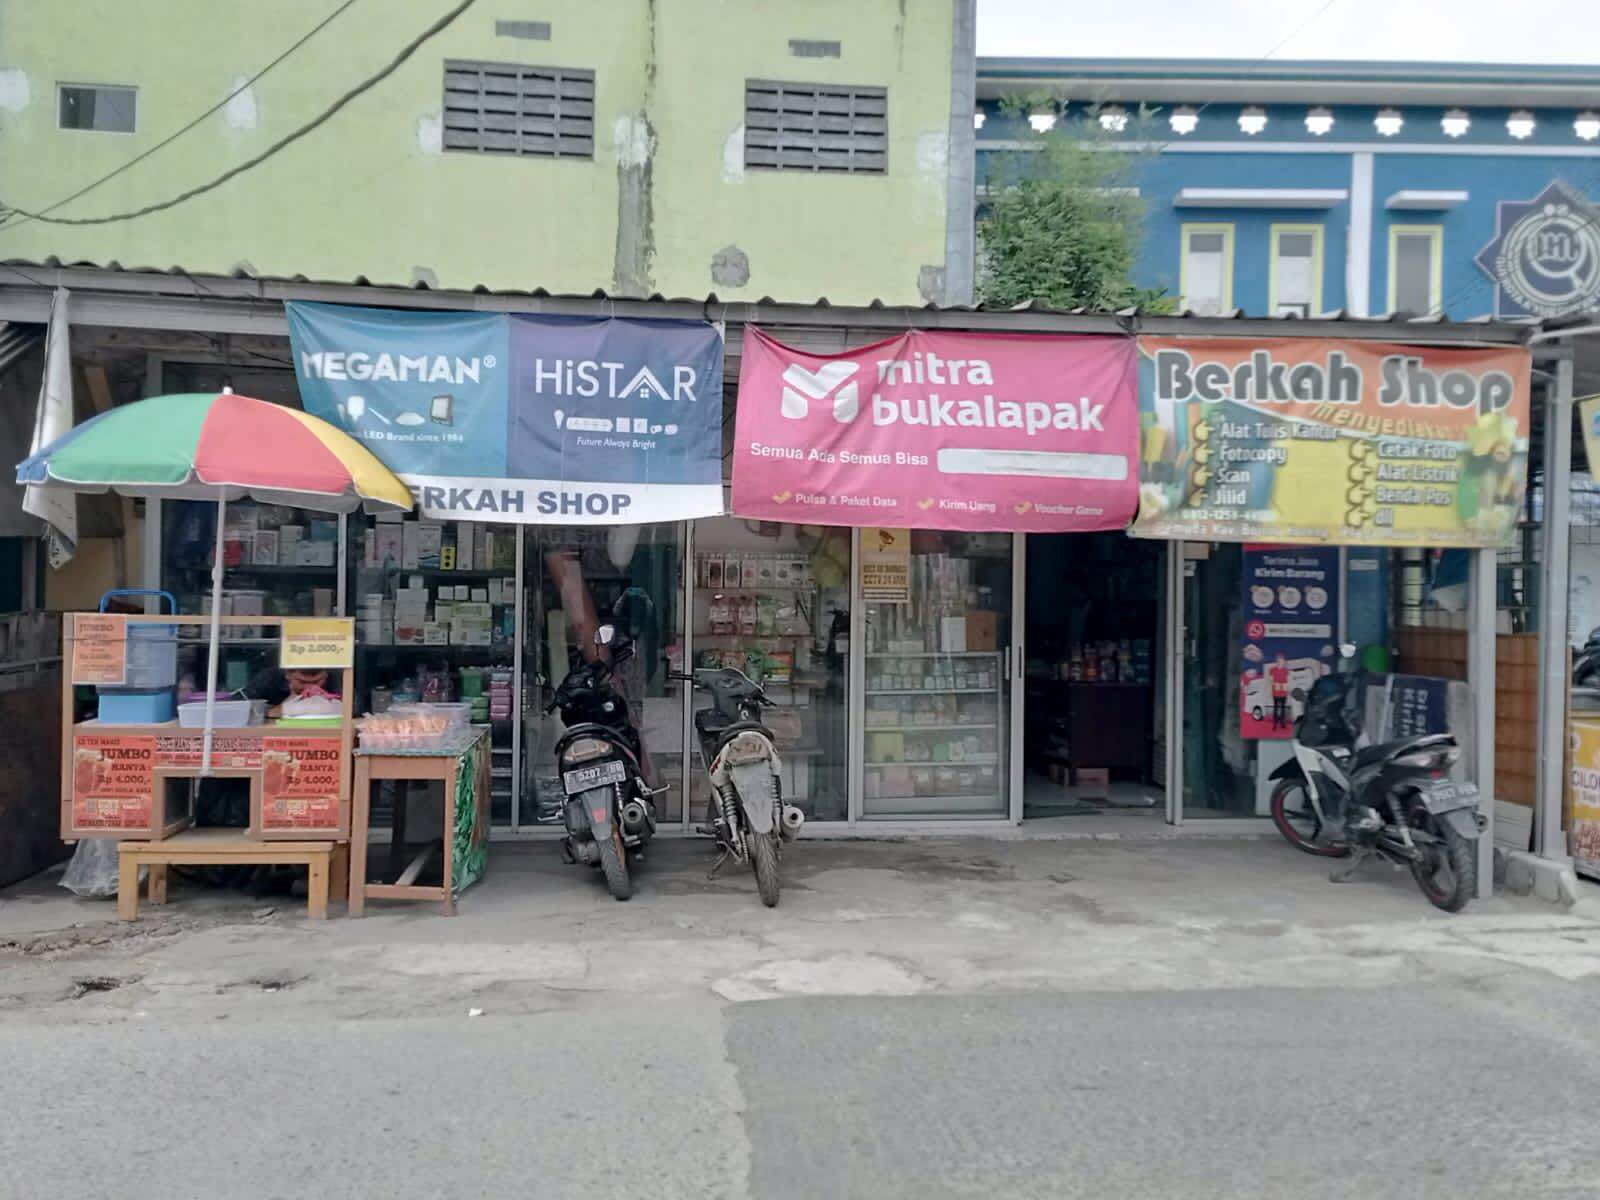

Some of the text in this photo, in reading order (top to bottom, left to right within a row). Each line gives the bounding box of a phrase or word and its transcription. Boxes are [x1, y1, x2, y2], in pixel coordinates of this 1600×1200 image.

[877, 352, 994, 386] mitra
[1154, 349, 1514, 414] Berkah Shop
[872, 394, 1105, 435] bukalapak
[386, 431, 415, 442] Brand
[416, 432, 440, 443] since
[1220, 423, 1249, 438] Alat
[577, 435, 656, 451] Future Always Bright
[1377, 442, 1457, 460] Cetak Foto
[751, 442, 803, 460] Semua
[839, 450, 891, 465] Semua
[895, 452, 929, 466] Bisa
[1219, 446, 1288, 465] Fotocopy
[1216, 468, 1250, 484] Scan
[1376, 463, 1459, 482] Alat Listrik
[408, 484, 632, 515] ERKAH SHOP
[795, 493, 827, 505] Pulsa
[840, 495, 870, 506] Paket
[872, 496, 897, 507] Data
[1214, 488, 1248, 505] Jilid
[1375, 486, 1450, 504] Benda Pos
[939, 500, 996, 513] Kirim Uang
[1034, 503, 1104, 516] Voucher Game
[1255, 567, 1326, 581] Kirim Barang
[289, 643, 305, 655] Rp
[98, 748, 151, 761] JUMBO
[286, 749, 339, 763] JUMBO
[111, 763, 146, 771] HANYA
[299, 764, 335, 772] HANYA
[1572, 769, 1600, 790] CILO
